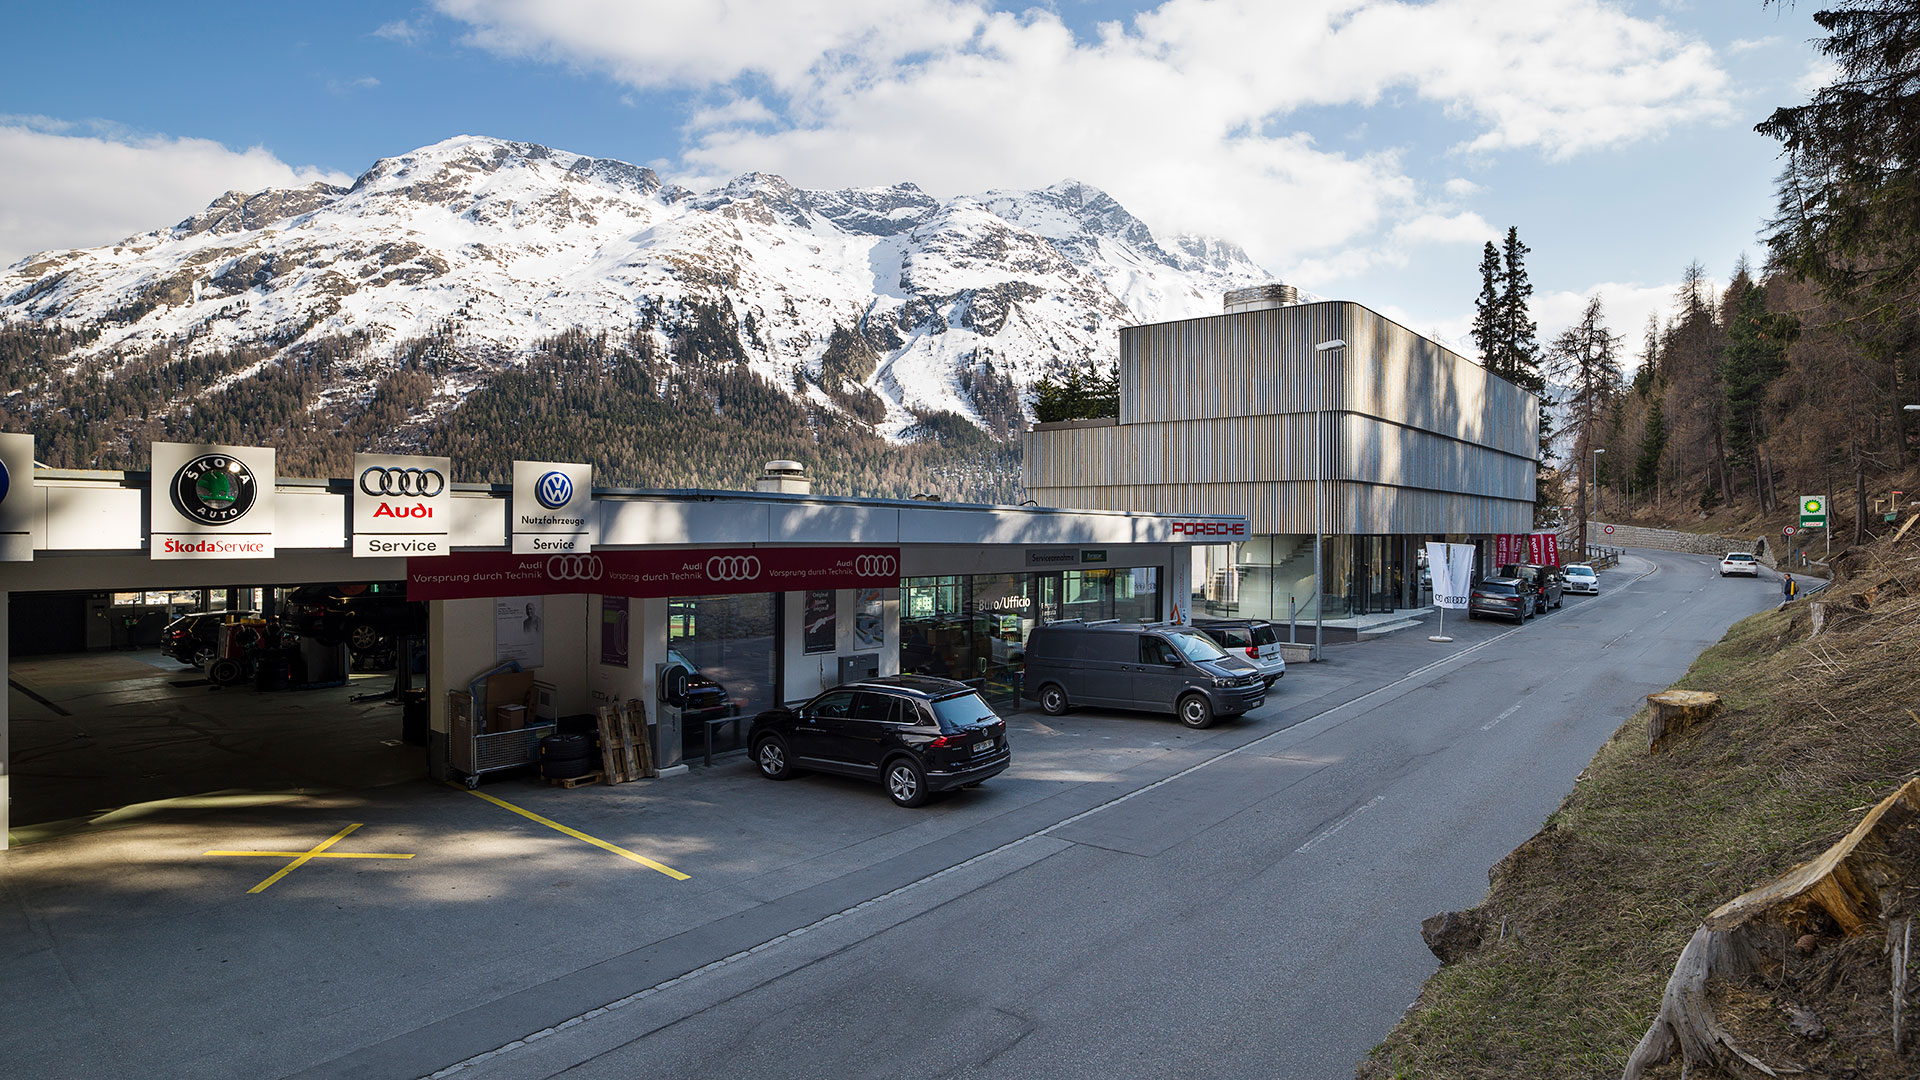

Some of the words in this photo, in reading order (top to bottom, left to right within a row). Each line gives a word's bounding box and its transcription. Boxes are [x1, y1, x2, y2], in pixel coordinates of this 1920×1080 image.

[197, 507, 238, 519] AUTO
[373, 502, 433, 518] Audi
[521, 515, 585, 527] Nutzfahrzeuge
[1172, 522, 1245, 536] PORSCHE
[164, 538, 264, 553] ŠkodaService
[368, 539, 437, 552] Service
[533, 537, 575, 550] Service
[518, 561, 543, 570] Audi
[682, 562, 703, 571] Audi
[413, 574, 470, 583] Vorsprung
[472, 572, 502, 581] durch
[505, 571, 542, 580] Technik
[642, 573, 669, 581] durch
[670, 570, 703, 580] Technik
[769, 569, 806, 578] Vorsprung
[807, 568, 827, 576] durch
[828, 567, 853, 576] Technik
